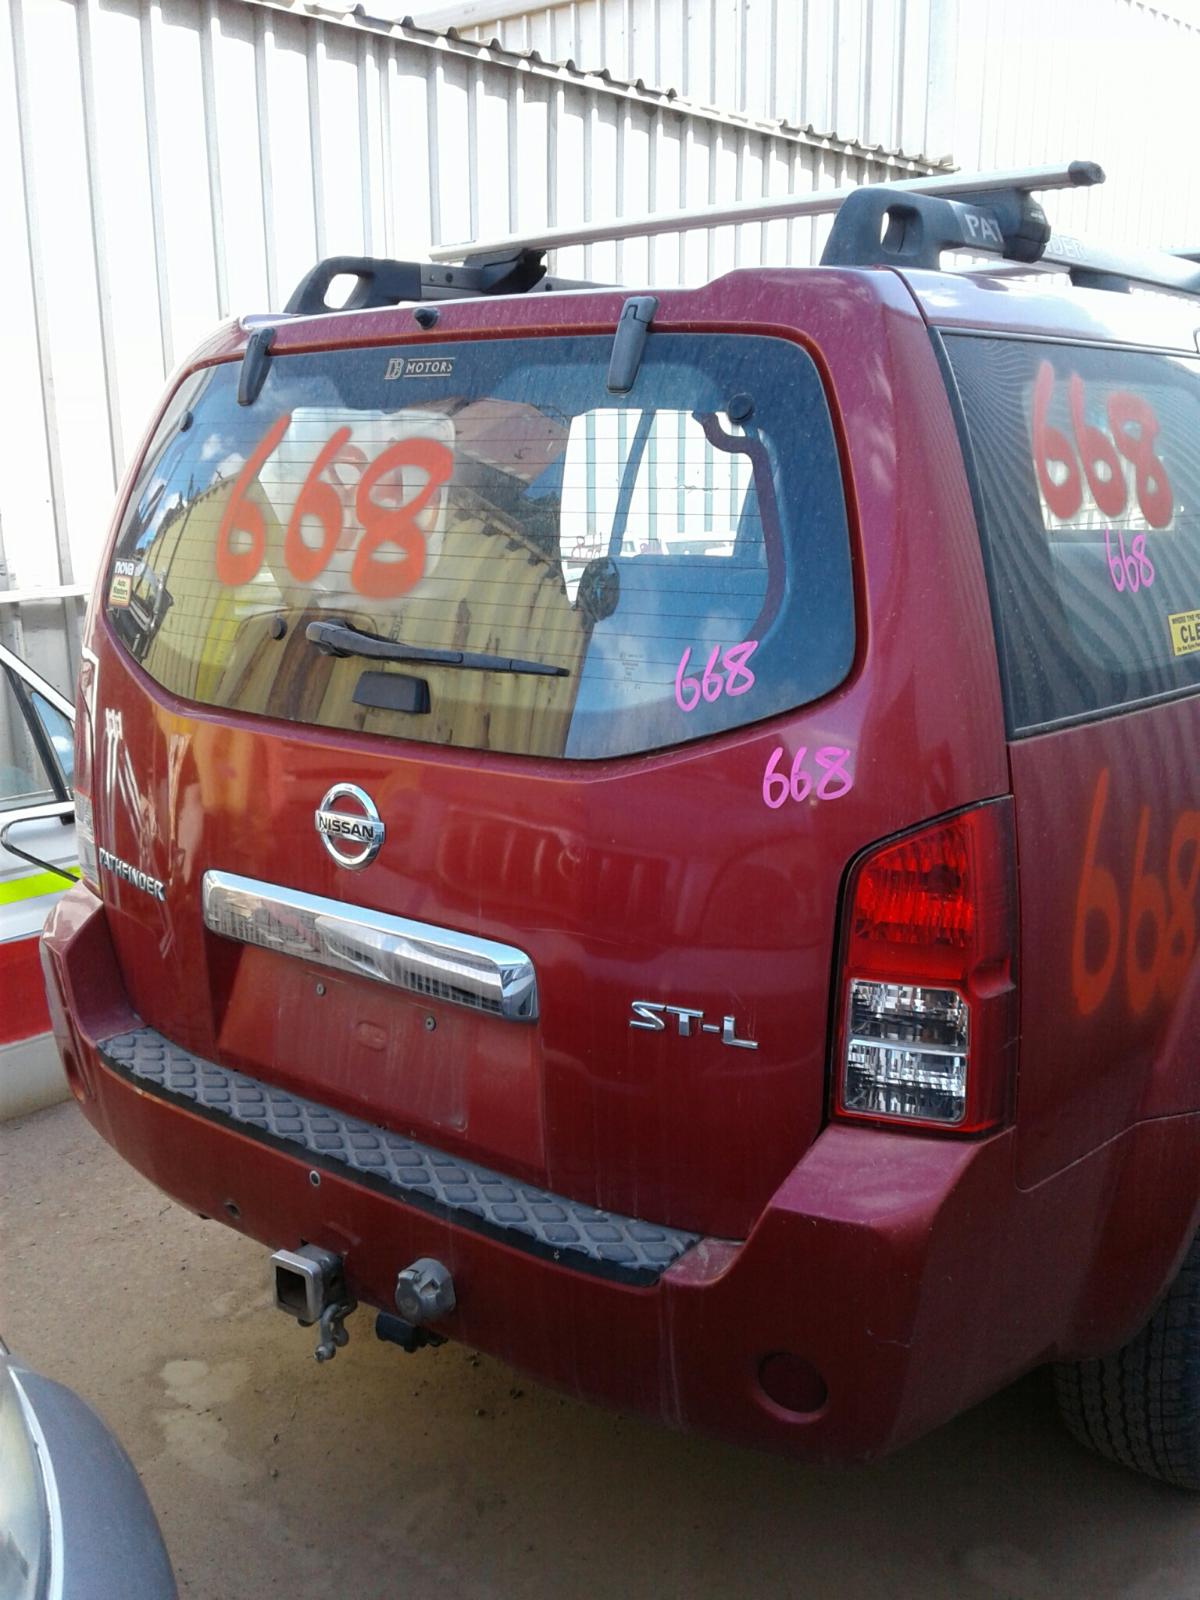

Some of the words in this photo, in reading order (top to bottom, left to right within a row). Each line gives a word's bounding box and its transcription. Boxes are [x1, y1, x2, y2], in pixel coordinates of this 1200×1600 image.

[1032, 360, 1174, 529] 668
[216, 415, 454, 600] 668
[1105, 528, 1155, 593] 668
[674, 640, 758, 713] 668
[763, 746, 854, 809] 668
[319, 815, 375, 841] NISSAN
[99, 847, 166, 902] PATHFINDER
[1072, 768, 1200, 1017] 668
[629, 1001, 759, 1050] ST-L
